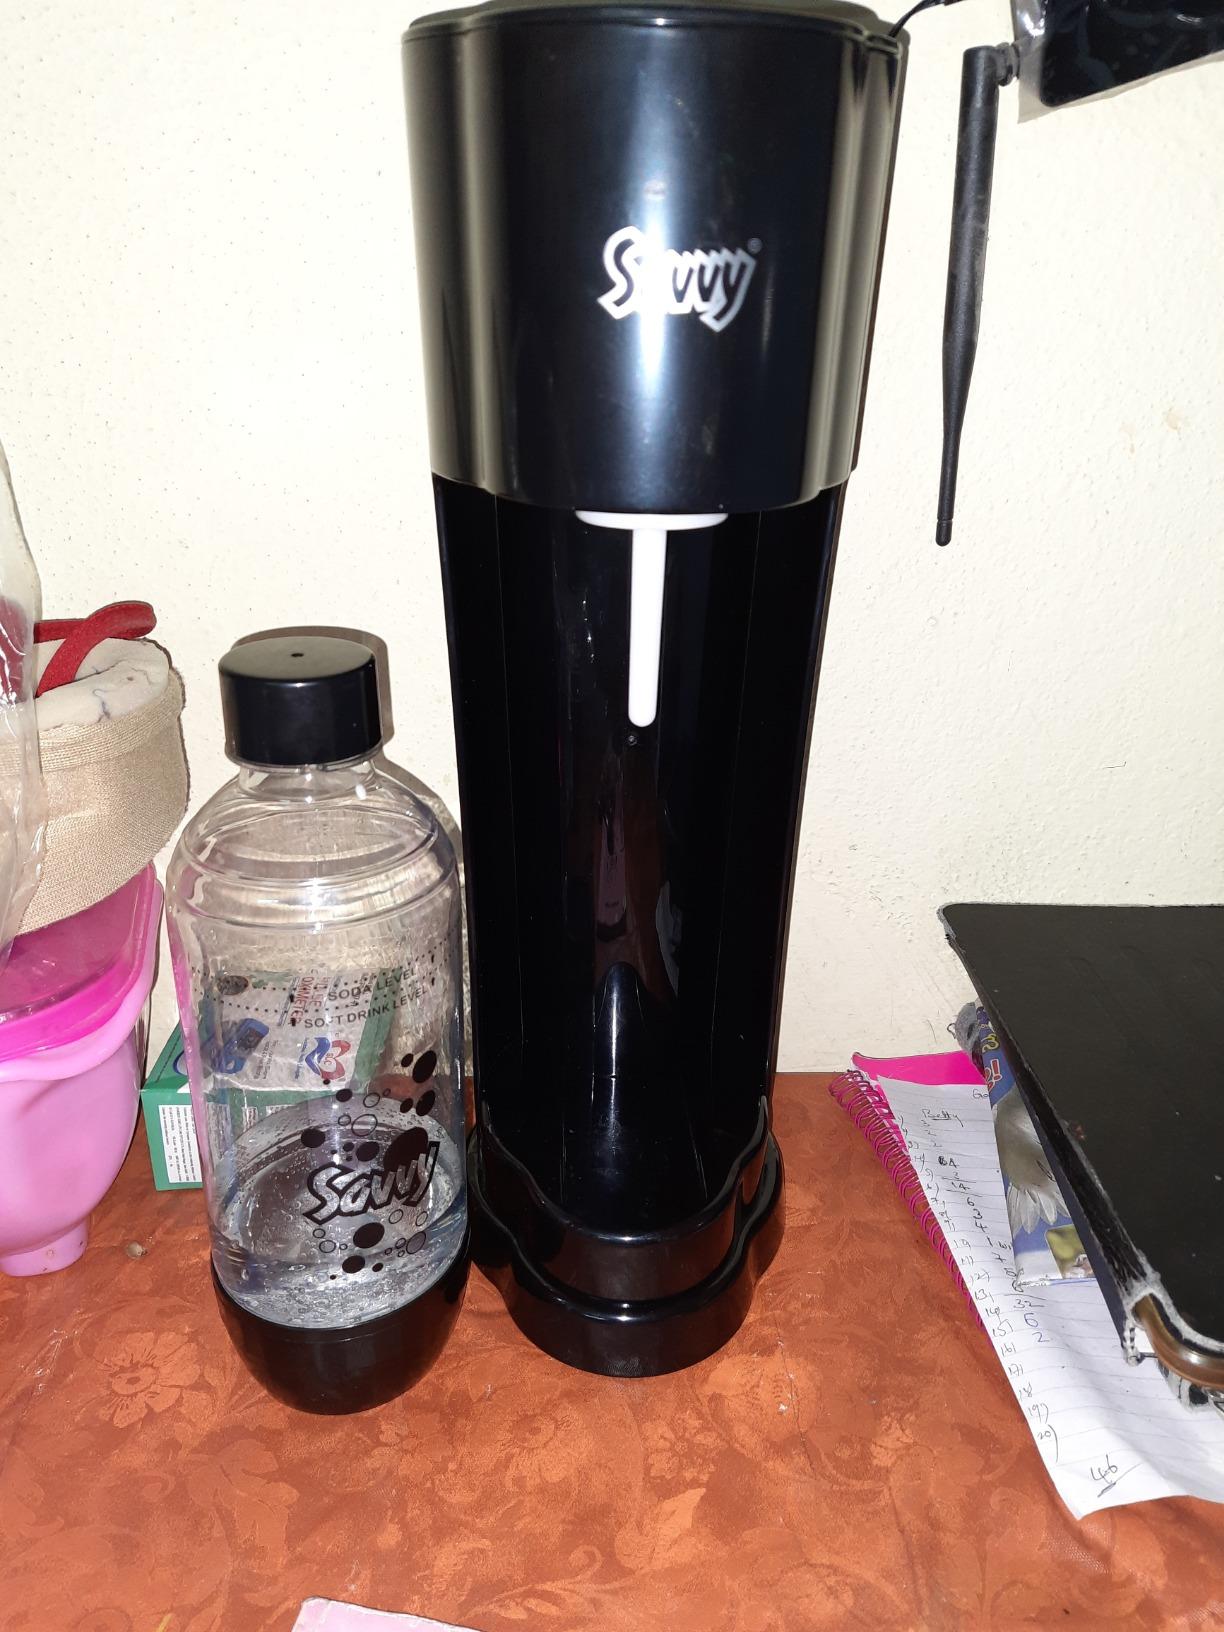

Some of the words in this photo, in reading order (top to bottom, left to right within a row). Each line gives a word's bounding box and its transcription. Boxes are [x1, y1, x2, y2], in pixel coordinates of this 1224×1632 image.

[328, 985, 372, 1001] SODA
[377, 967, 417, 991] LEVEL
[347, 1004, 390, 1023] DRINK
[393, 987, 428, 1009] LEVEL
